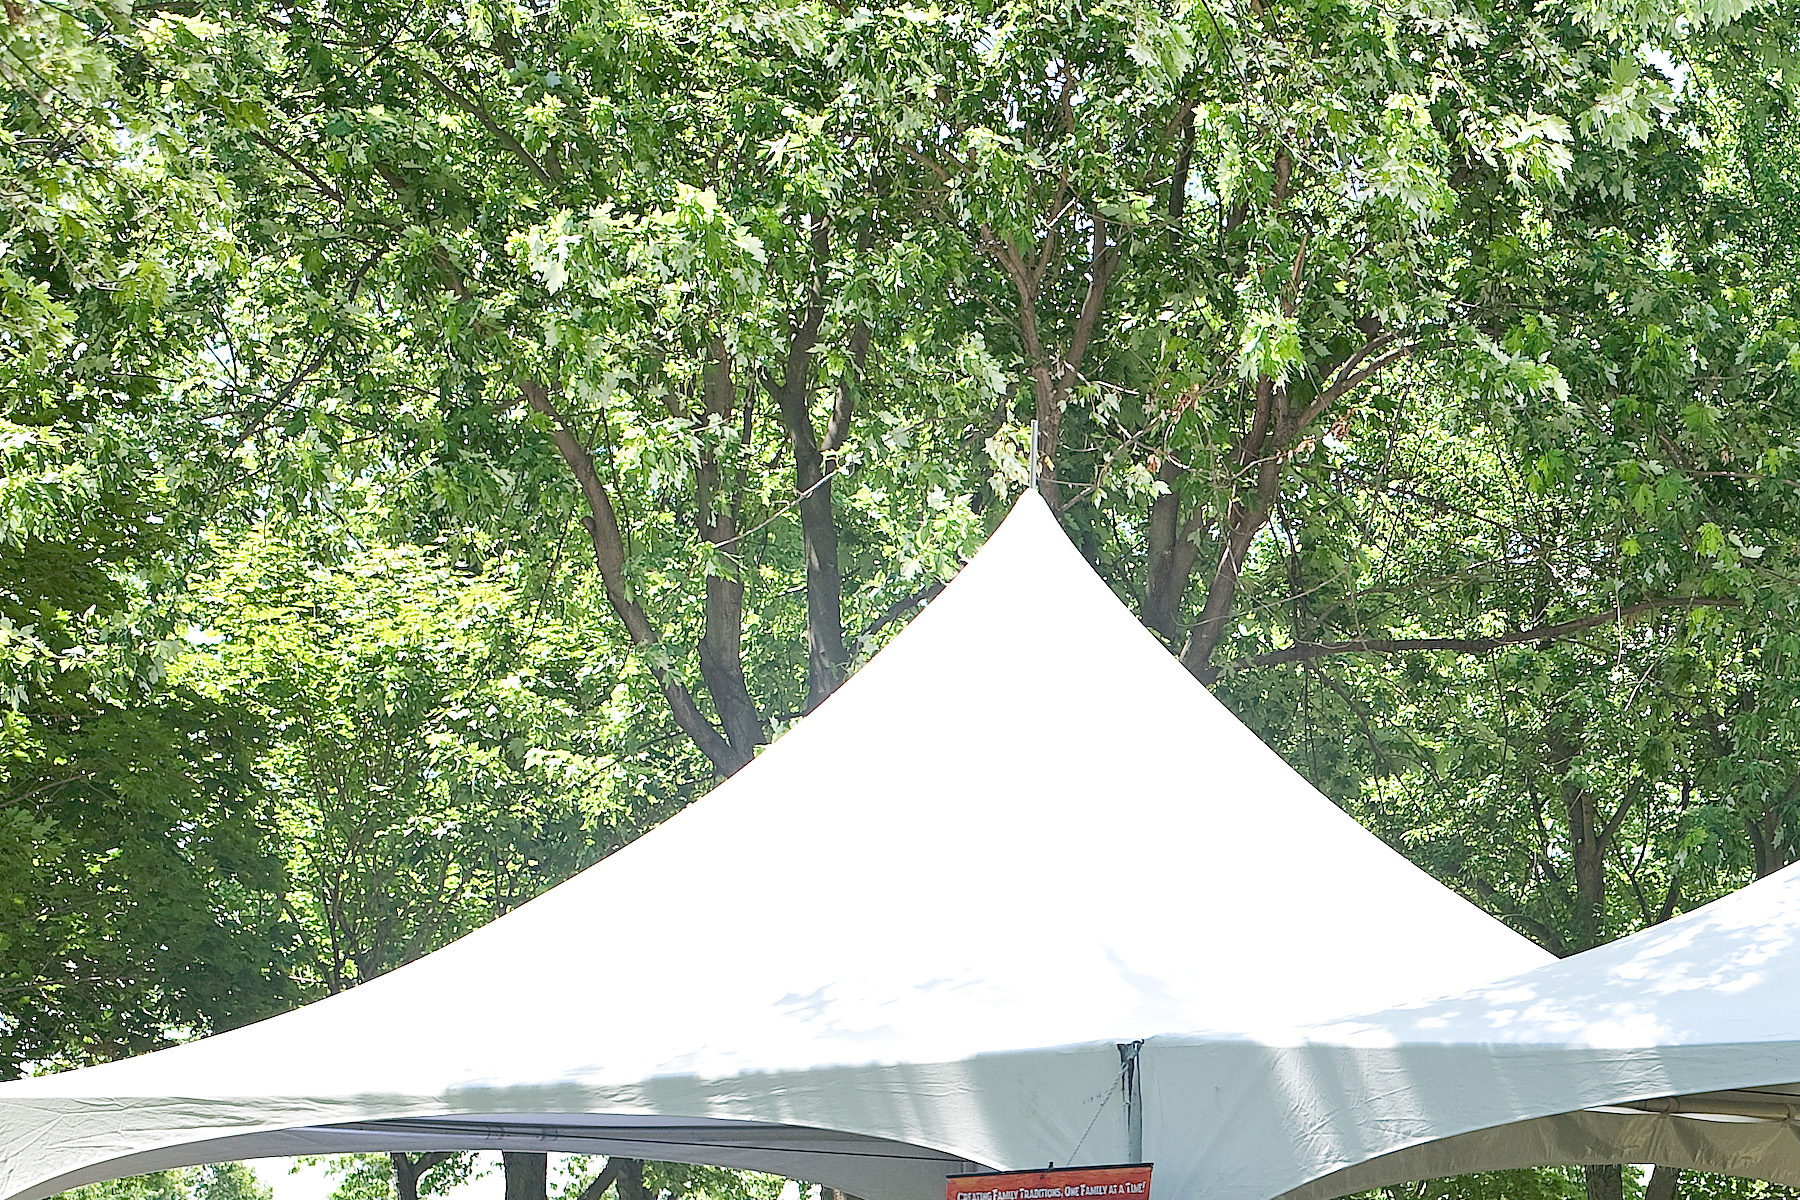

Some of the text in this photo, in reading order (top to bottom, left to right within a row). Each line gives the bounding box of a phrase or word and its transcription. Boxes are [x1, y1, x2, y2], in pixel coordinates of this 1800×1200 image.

[992, 1188, 1019, 1200] FAMILY
[1064, 1185, 1079, 1198] ONE
[1080, 1183, 1107, 1196] FAMILY
[1108, 1184, 1117, 1195] AT
[1118, 1184, 1125, 1194] A
